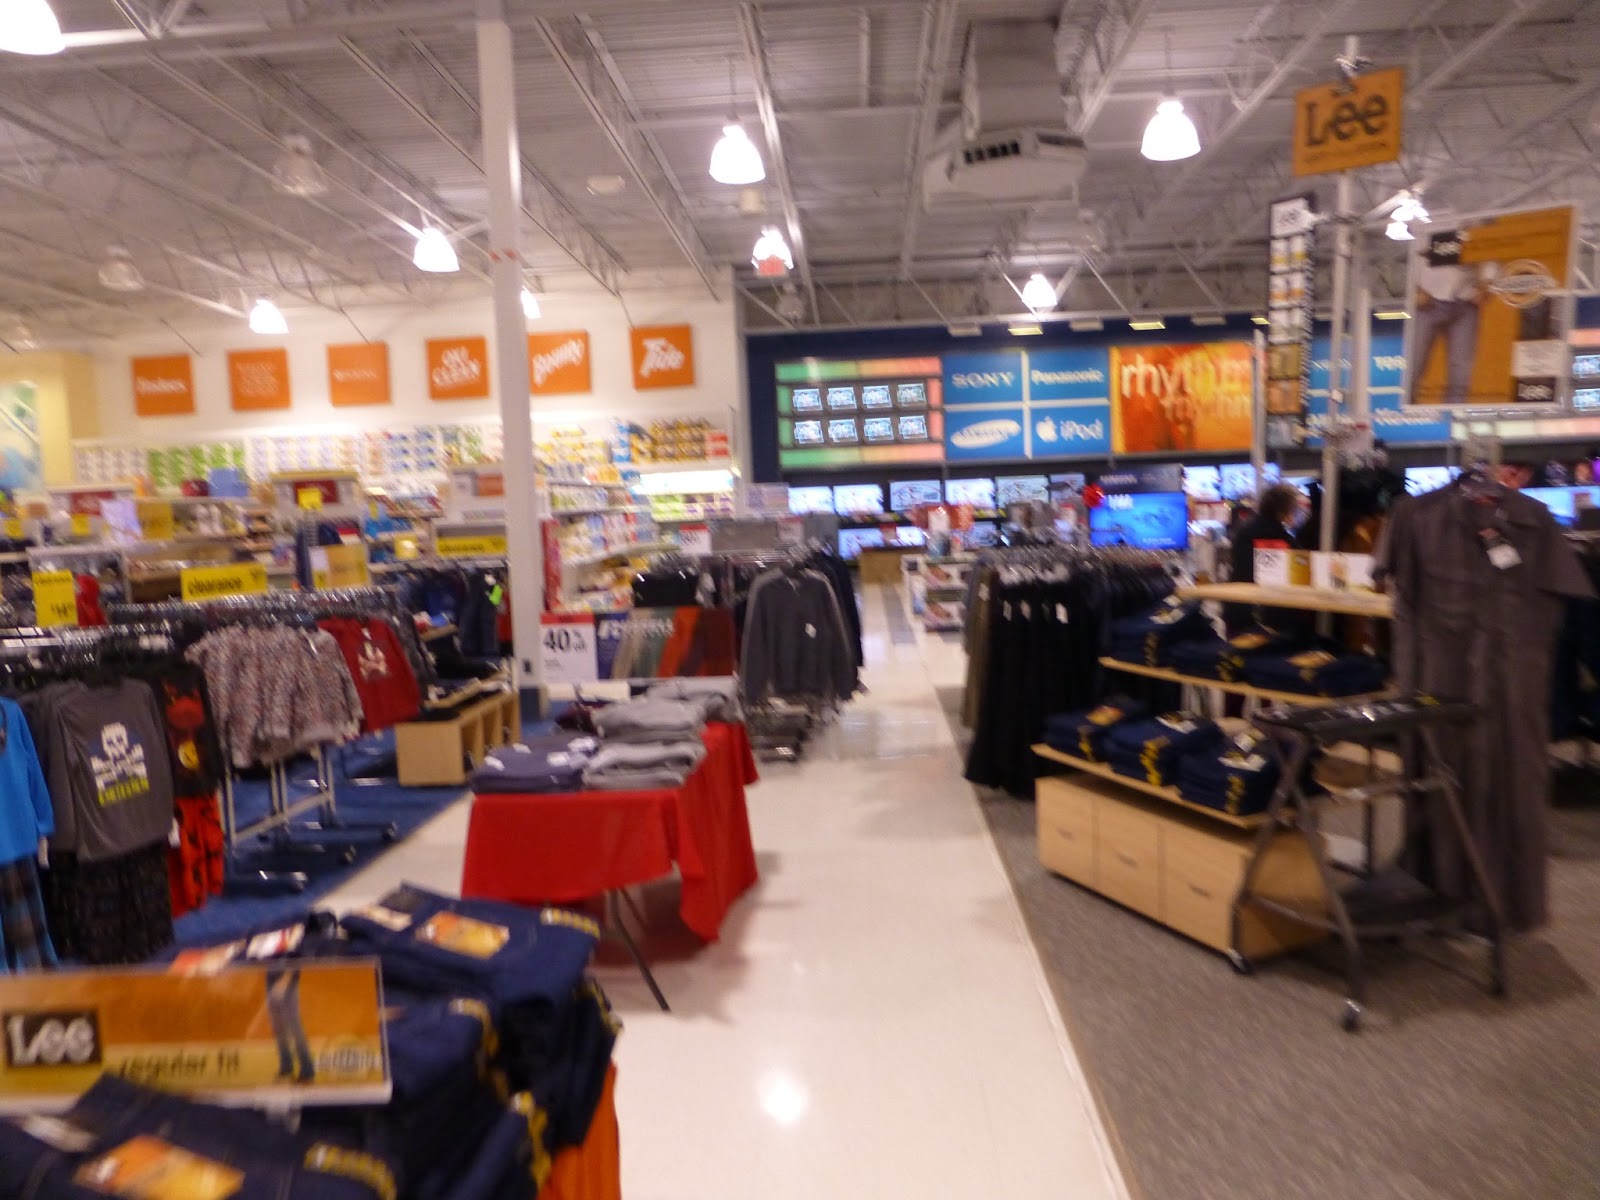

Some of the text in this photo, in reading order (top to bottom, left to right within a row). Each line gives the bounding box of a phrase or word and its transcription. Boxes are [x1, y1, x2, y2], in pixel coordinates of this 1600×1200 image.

[1304, 93, 1389, 147] Lee
[951, 371, 1015, 389] SONY
[1031, 368, 1105, 385] Panasonic
[1060, 418, 1104, 441] iPod
[542, 628, 571, 652] 40
[6, 1013, 96, 1067] Lee
